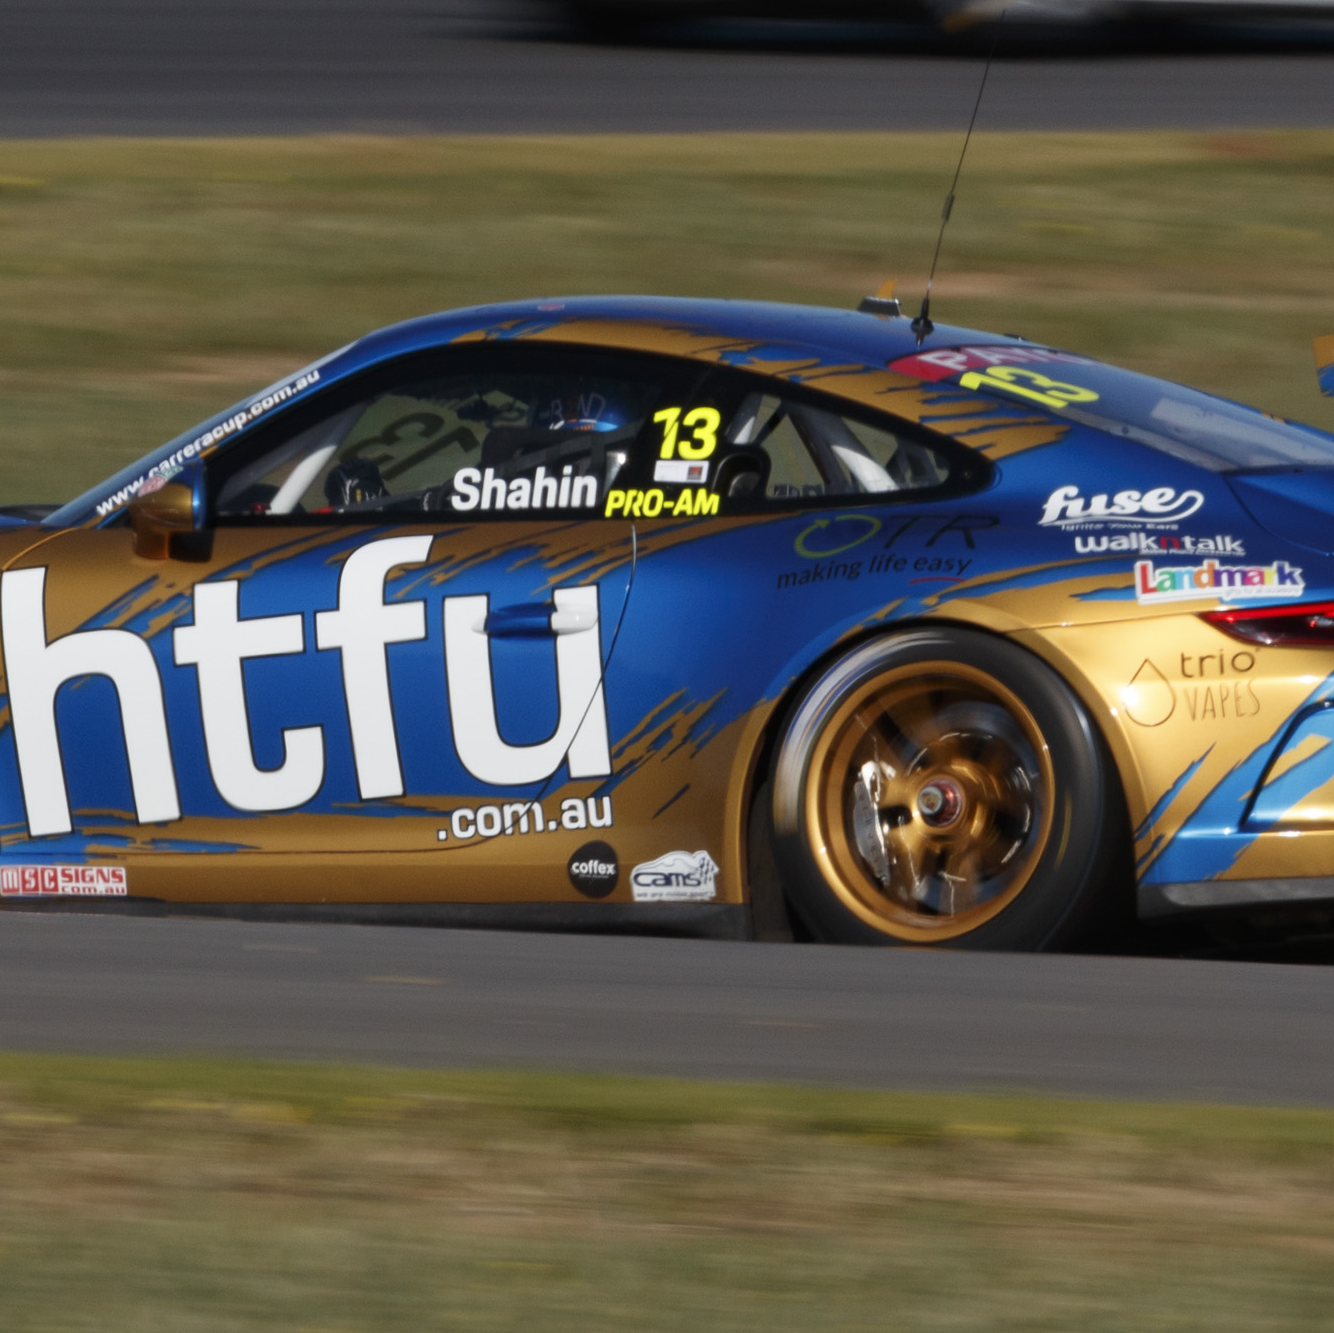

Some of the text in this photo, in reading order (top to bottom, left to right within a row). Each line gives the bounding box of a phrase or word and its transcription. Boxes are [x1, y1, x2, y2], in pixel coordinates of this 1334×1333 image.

[959, 366, 1100, 409] 13
[654, 407, 721, 460] 13
[451, 465, 598, 511] Shahin
[604, 488, 720, 518] PRO-AM
[1037, 485, 1204, 526] fuse
[777, 554, 972, 590] making life easy
[1139, 562, 1301, 594] Landmark
[1180, 648, 1256, 679] trio
[0, 535, 612, 837] htfu
[1183, 679, 1261, 722] VAPES
[436, 795, 614, 841] .com.au
[60, 867, 124, 884] SIGNS
[571, 859, 616, 875] coffex
